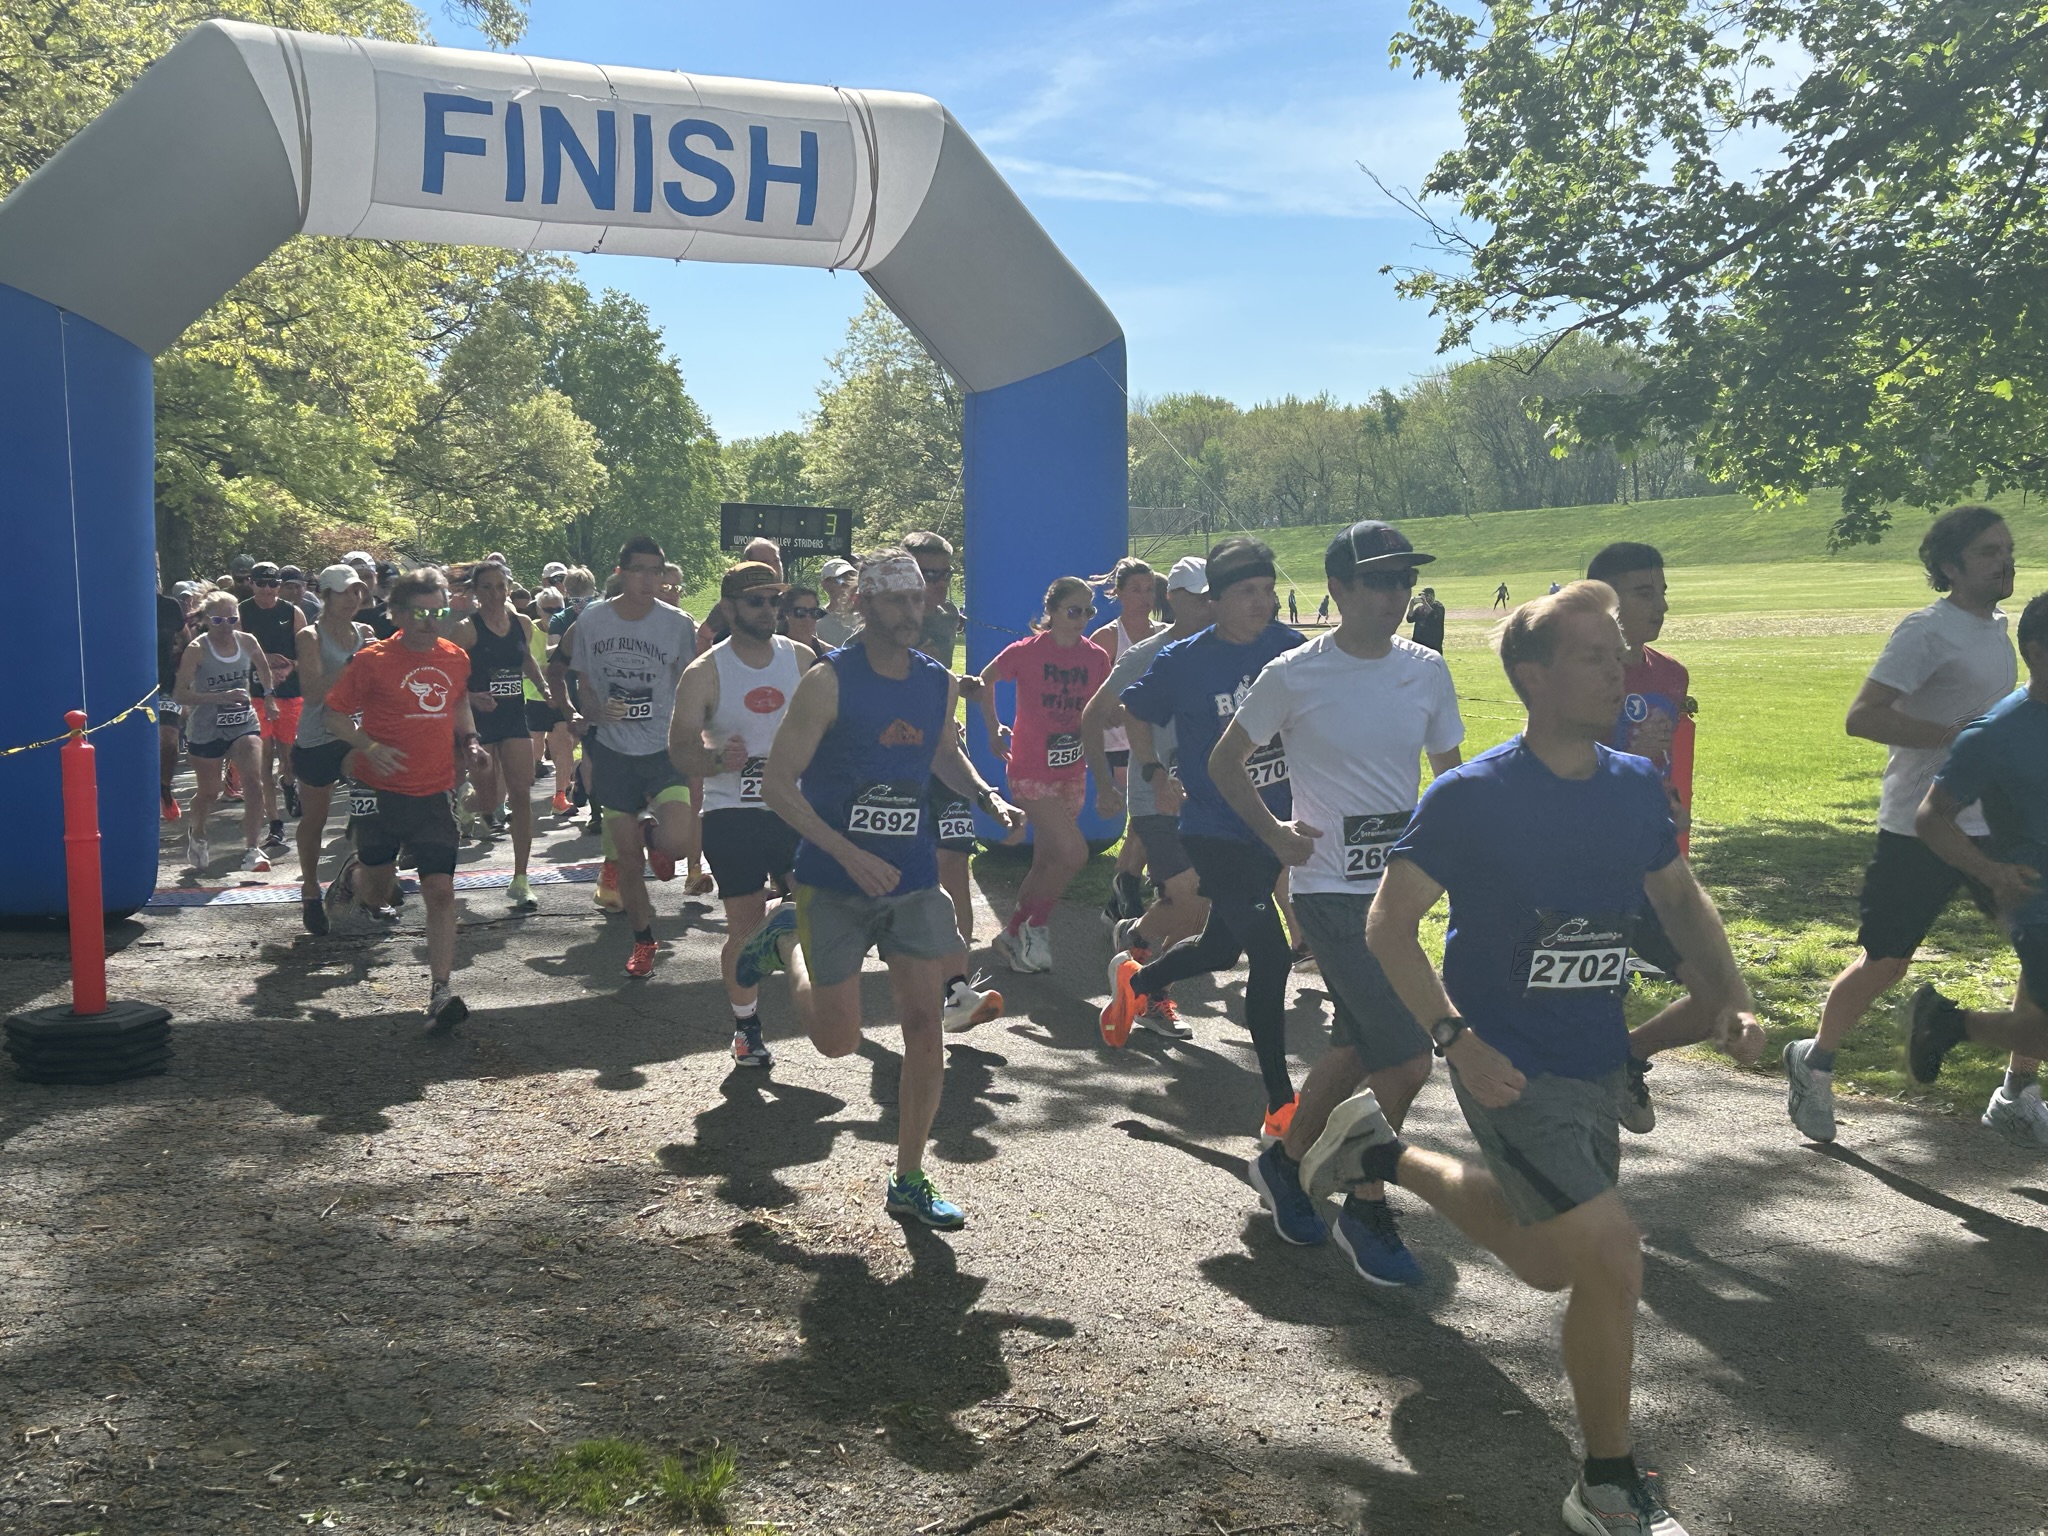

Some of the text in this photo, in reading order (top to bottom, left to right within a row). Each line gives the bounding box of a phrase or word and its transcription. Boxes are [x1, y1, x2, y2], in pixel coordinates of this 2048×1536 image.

[421, 92, 819, 226] FINISH
[793, 538, 824, 549] STRIDERS
[627, 704, 651, 718] 09
[1247, 759, 1289, 786] 270
[851, 808, 917, 832] 2692
[1530, 952, 1621, 984] 2702
